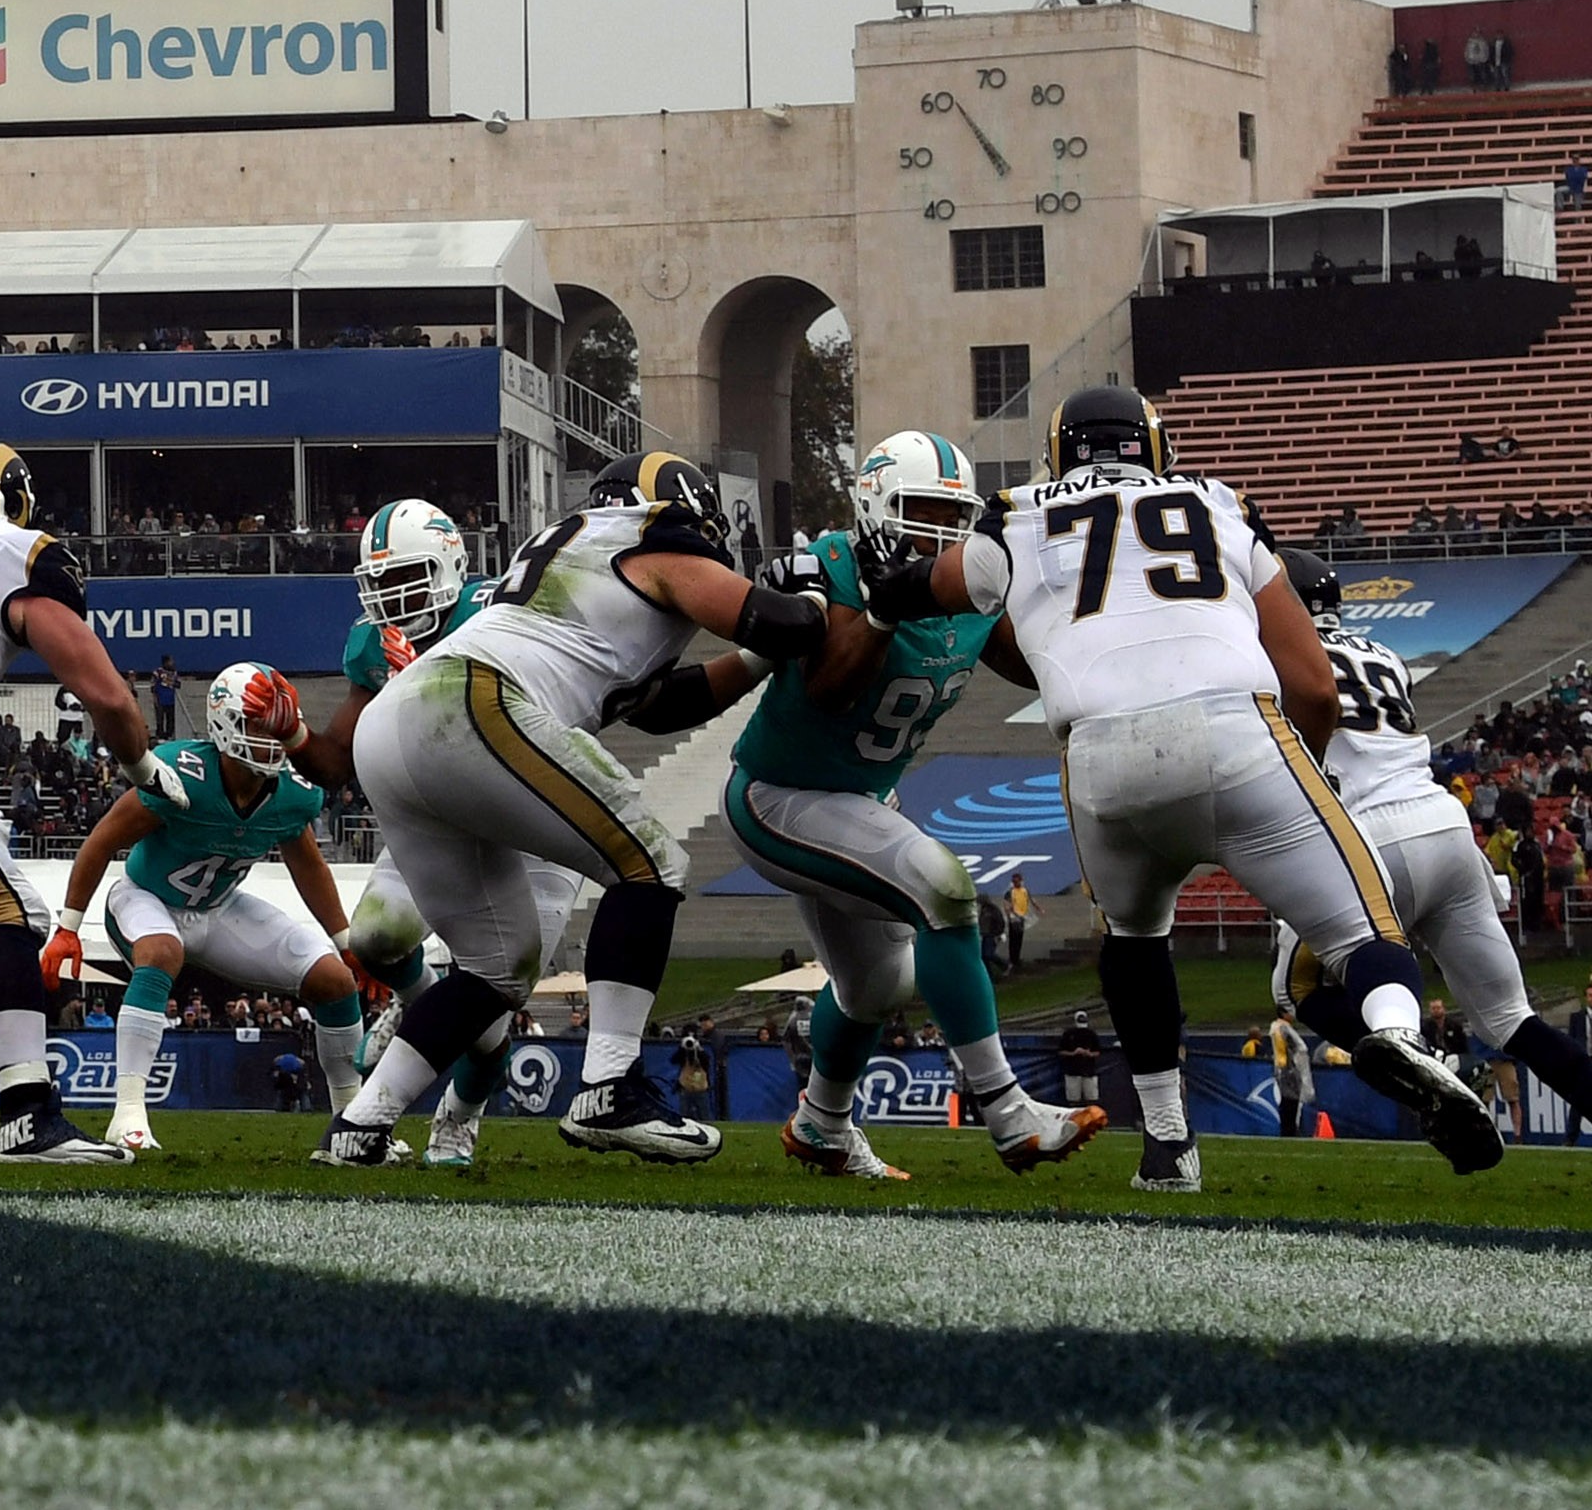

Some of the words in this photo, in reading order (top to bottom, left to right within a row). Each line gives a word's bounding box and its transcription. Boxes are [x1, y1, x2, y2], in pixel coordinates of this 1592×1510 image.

[40, 13, 388, 83] Chevron
[976, 68, 1006, 89] 70
[921, 91, 954, 114] 60
[1031, 84, 1065, 106] 80
[900, 147, 933, 169] 50
[1053, 136, 1087, 160] 90
[924, 199, 955, 220] 40
[1035, 191, 1081, 214] 100
[98, 380, 270, 408] HYUNDAI
[1046, 491, 1228, 623] 79
[177, 749, 206, 782] 47
[86, 1052, 113, 1060] LOS
[916, 1071, 941, 1079] LOS
[571, 1085, 615, 1122] NIKE
